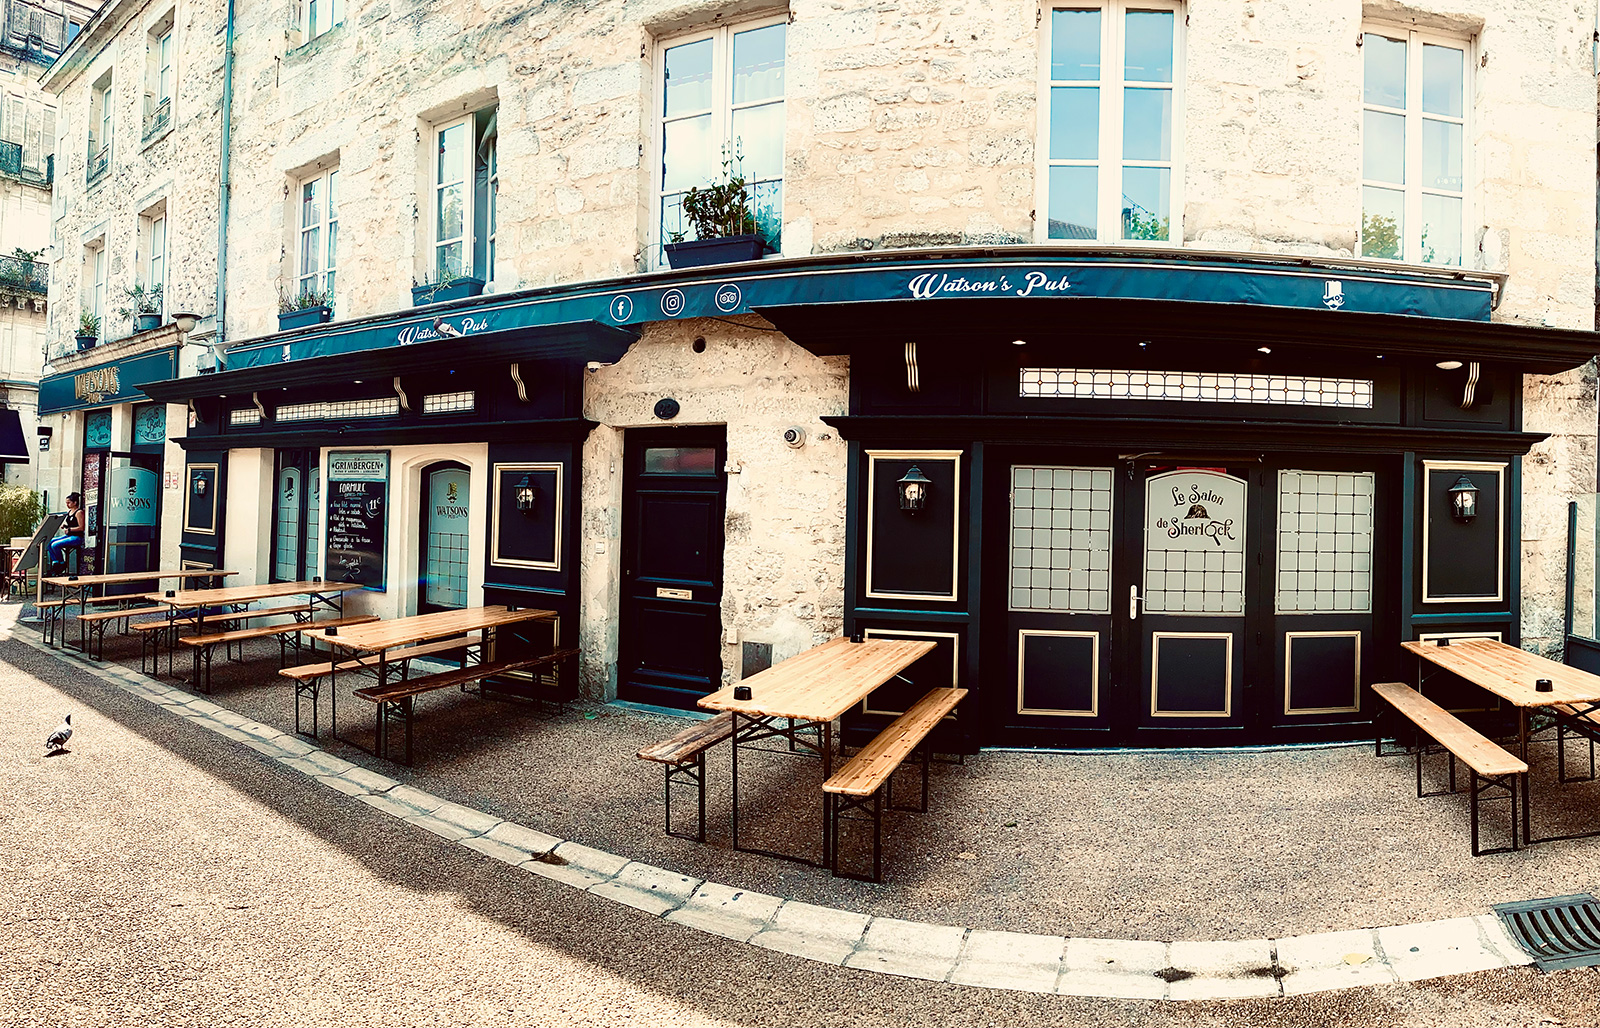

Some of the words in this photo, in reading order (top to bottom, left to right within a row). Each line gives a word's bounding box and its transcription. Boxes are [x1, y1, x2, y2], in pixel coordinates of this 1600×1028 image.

[908, 273, 1013, 299] Watson's
[1016, 271, 1071, 297] Pub
[397, 326, 441, 346] Watso
[461, 317, 489, 337] Pub
[74, 366, 120, 400] WATSONS
[334, 461, 380, 470] GRIMBERGEN
[1171, 486, 1186, 507] Le
[1188, 484, 1224, 505] Salon
[436, 505, 468, 518] WATSONS
[1156, 517, 1168, 528] de
